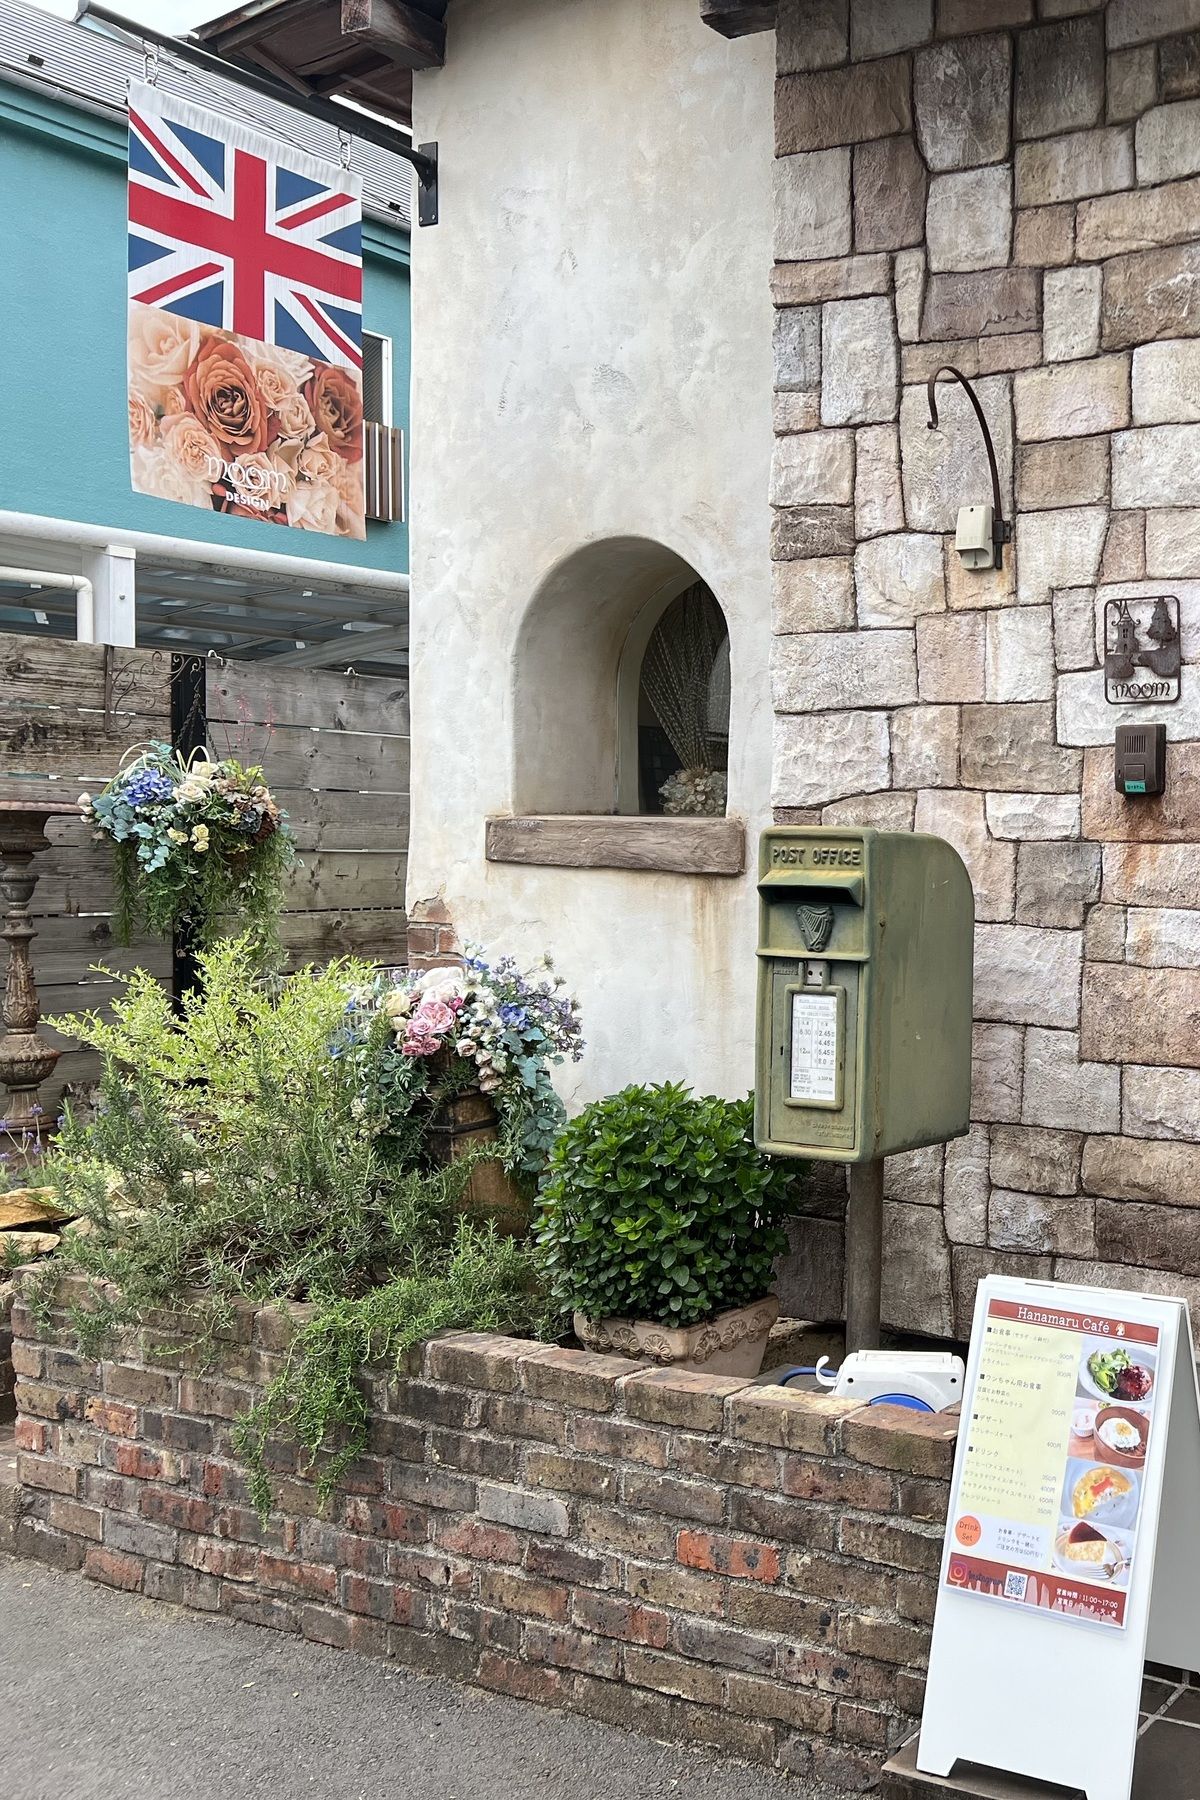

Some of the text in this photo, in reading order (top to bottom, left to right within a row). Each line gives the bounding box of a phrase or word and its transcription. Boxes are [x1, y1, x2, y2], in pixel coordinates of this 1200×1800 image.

[225, 491, 270, 508] DESIGN
[772, 846, 861, 866] POST OFFICE
[1017, 1306, 1110, 1334] Hanamaru Café
[979, 1413, 1003, 1425] デザート
[975, 1446, 998, 1457] ドリンク
[959, 1520, 978, 1532] Drink
[962, 1532, 972, 1542] Set
